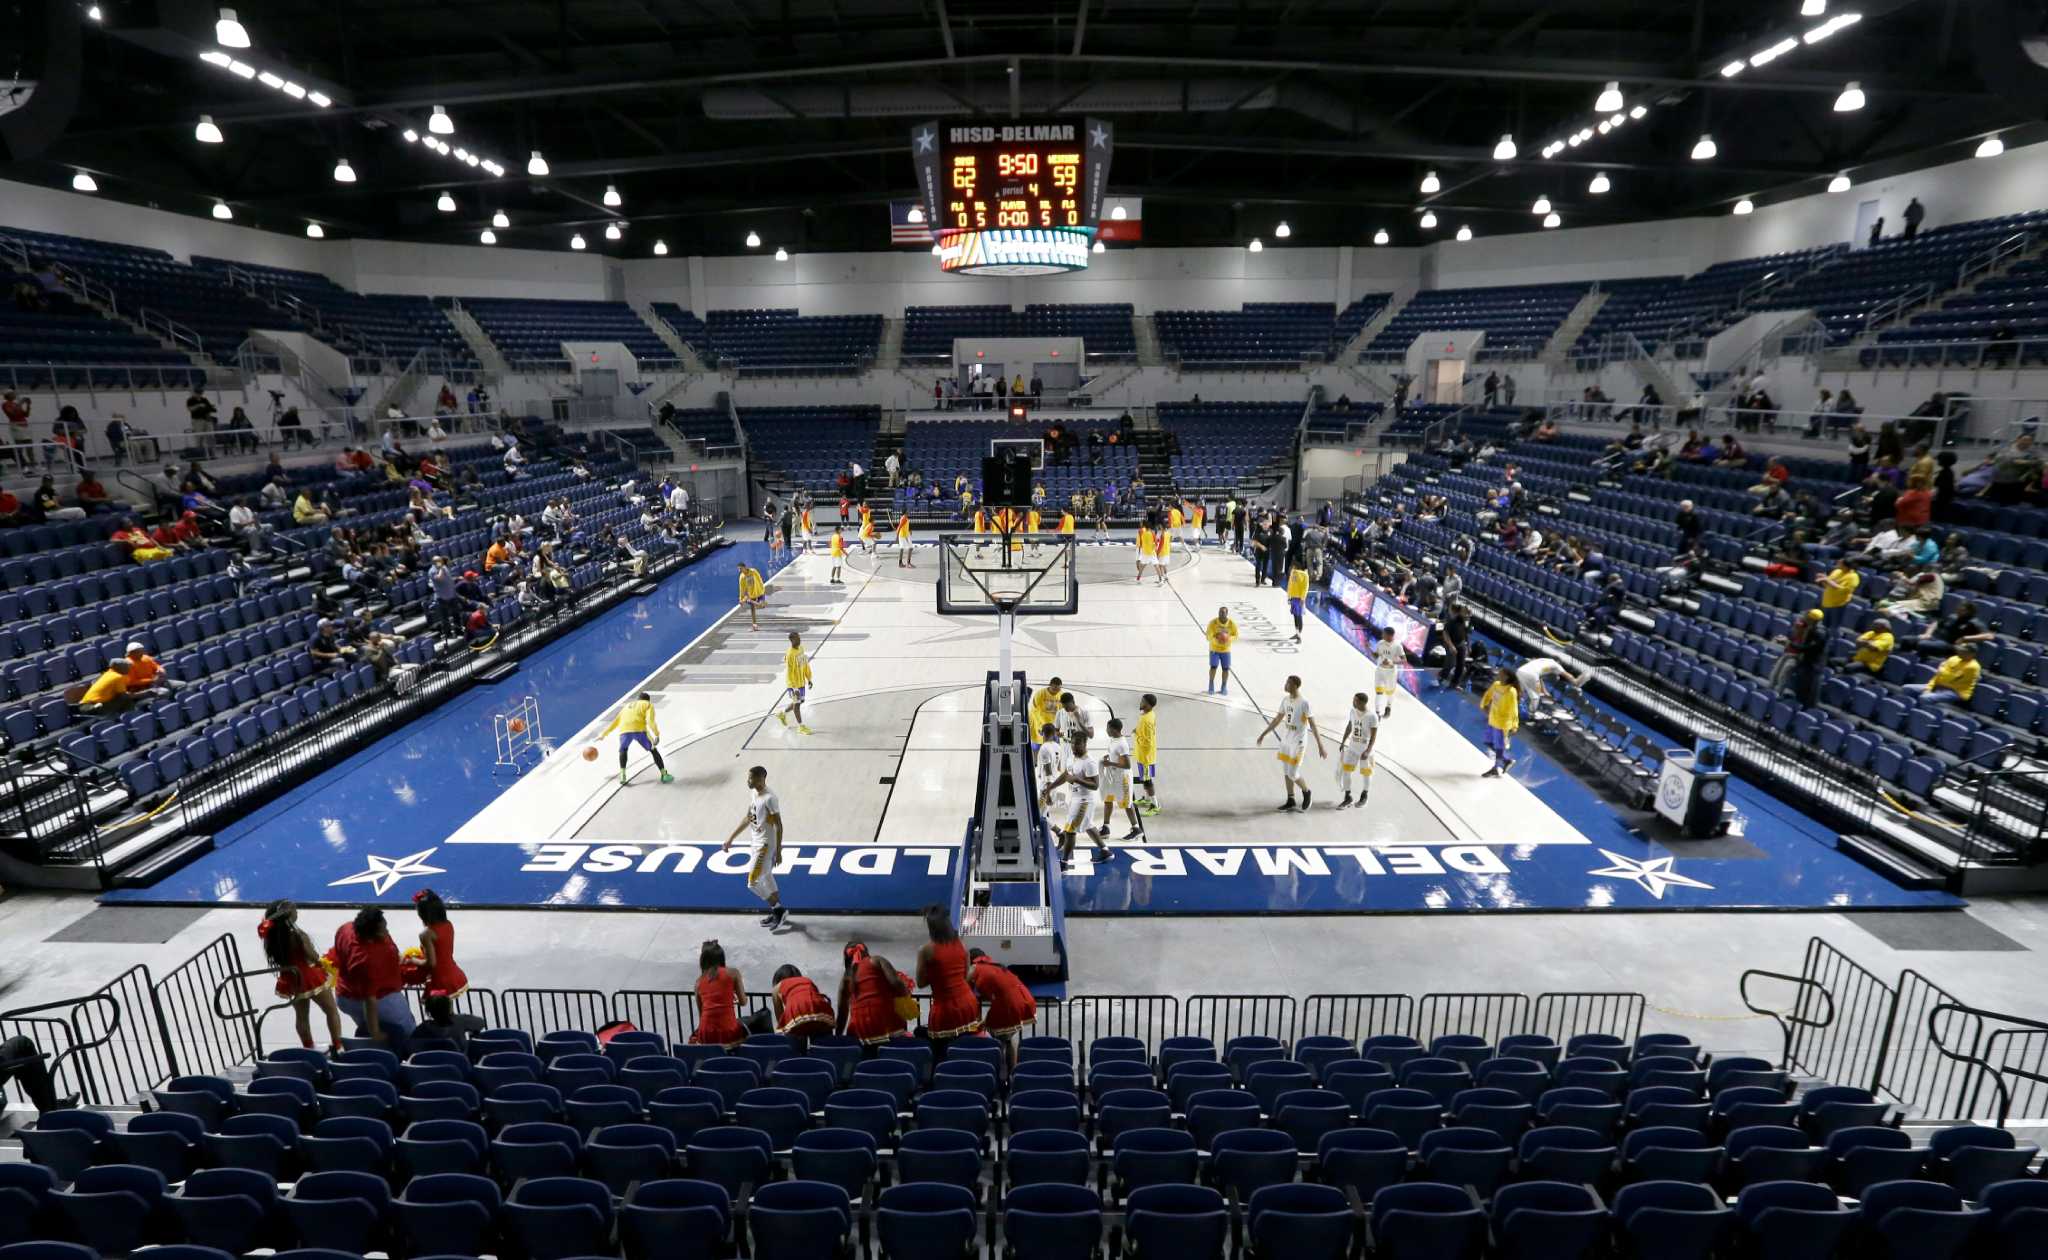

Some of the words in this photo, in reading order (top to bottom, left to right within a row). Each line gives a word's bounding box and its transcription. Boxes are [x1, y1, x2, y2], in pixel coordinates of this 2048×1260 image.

[950, 125, 1075, 143] HISD-DELMAR
[999, 153, 1038, 175] 9:50
[953, 167, 977, 188] 62
[1053, 165, 1076, 186] 59
[1028, 183, 1039, 197] 4
[958, 212, 968, 227] 0
[976, 212, 986, 227] 5
[998, 211, 1029, 227] 0-00
[1041, 210, 1051, 226] 5
[1067, 210, 1077, 225] 0
[1123, 846, 1511, 876] DELMAR
